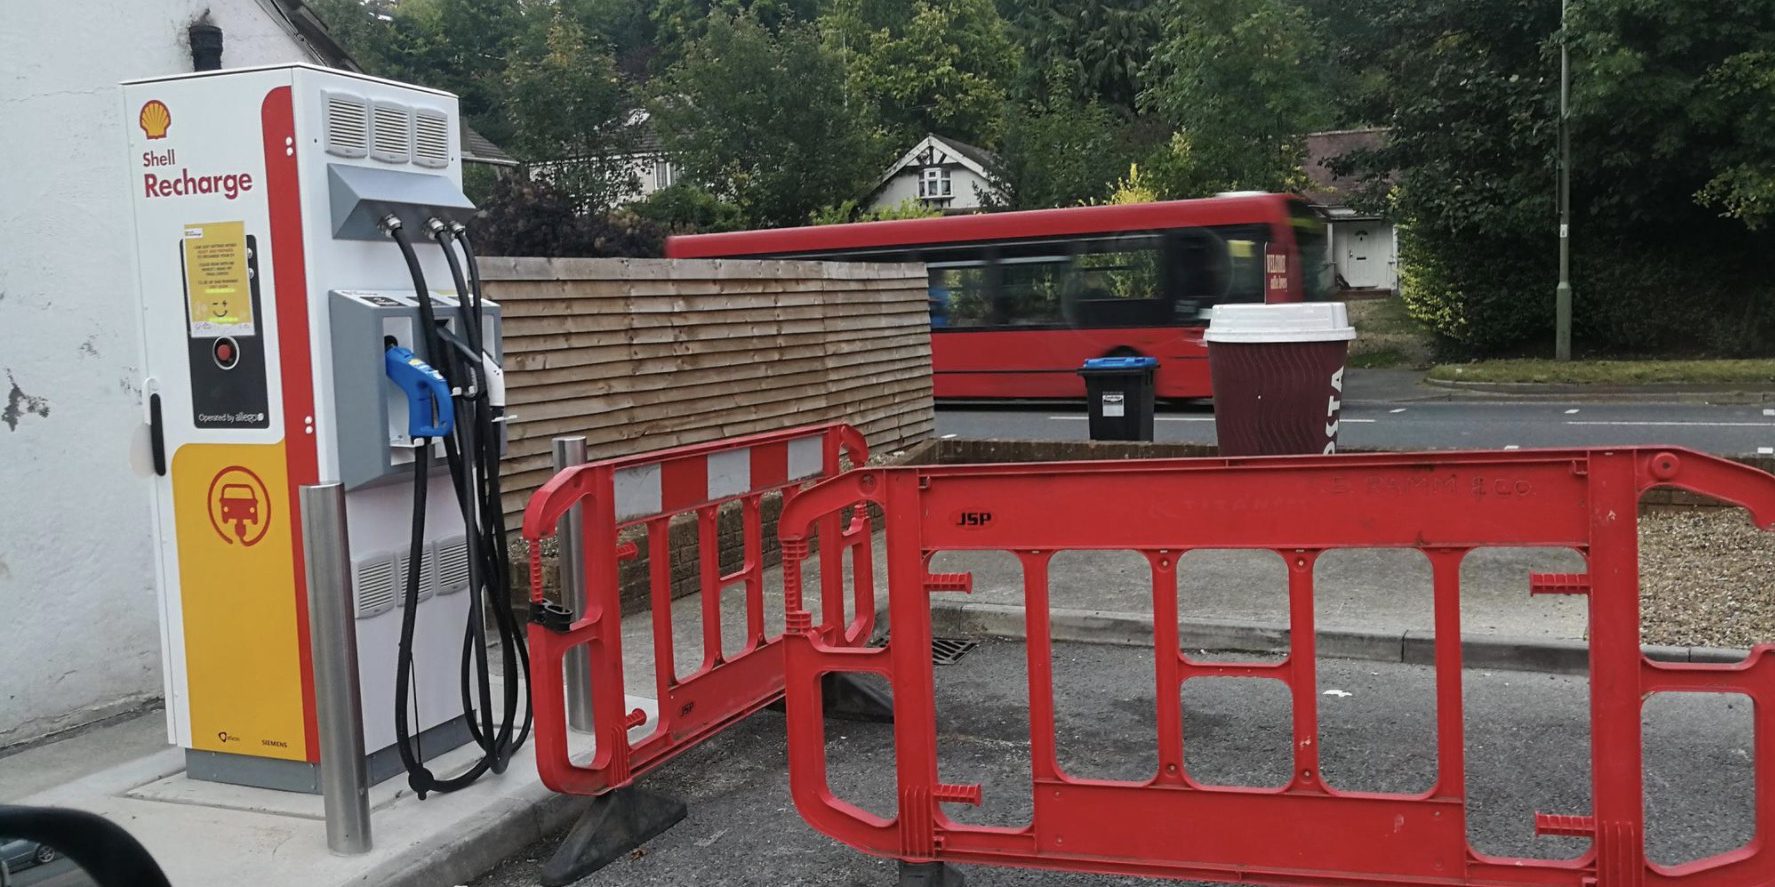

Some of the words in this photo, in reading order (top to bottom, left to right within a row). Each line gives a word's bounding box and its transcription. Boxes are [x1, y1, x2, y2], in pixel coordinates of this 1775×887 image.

[142, 148, 176, 167] Shell
[144, 168, 253, 200] Recharge
[227, 413, 235, 424] by
[1323, 366, 1345, 456] OSTA
[956, 512, 992, 526] JSP
[261, 739, 288, 749] SIEMENS
